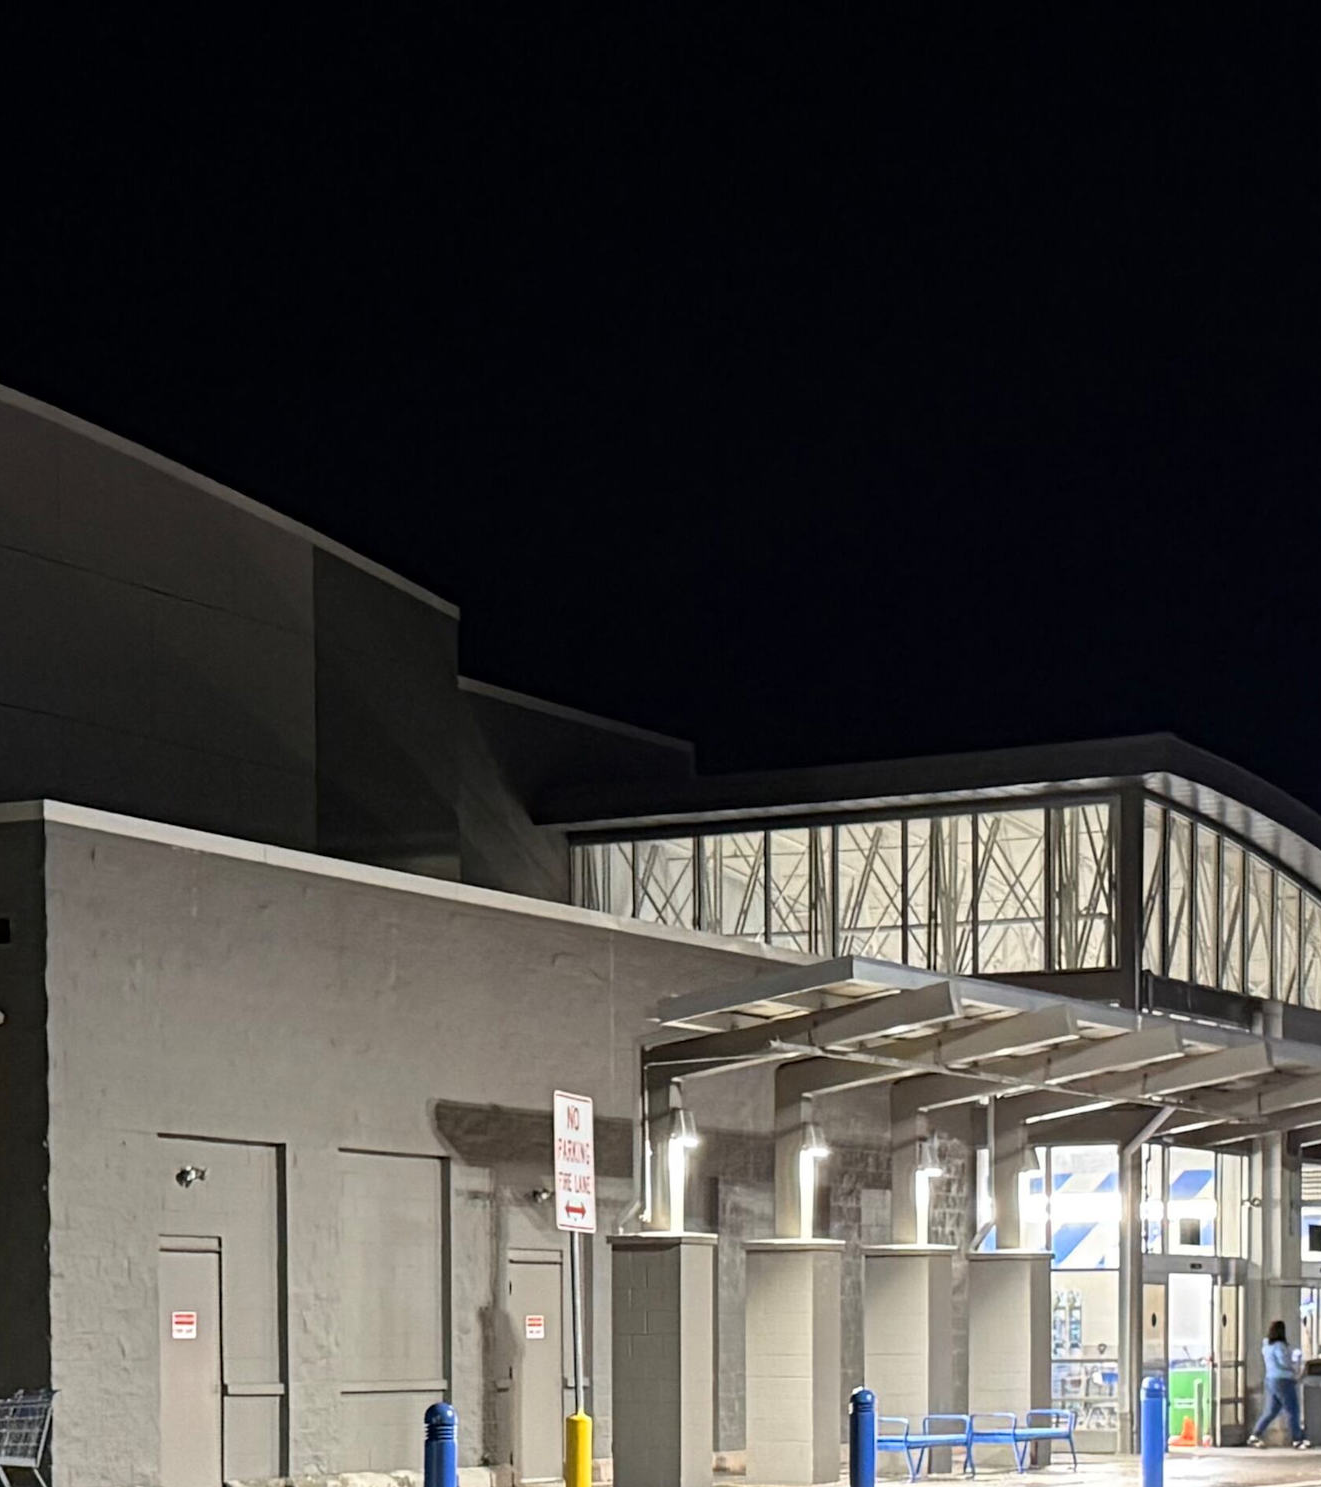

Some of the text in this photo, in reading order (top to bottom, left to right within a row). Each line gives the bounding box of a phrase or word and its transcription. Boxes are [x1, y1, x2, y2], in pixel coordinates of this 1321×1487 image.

[567, 1105, 580, 1131] NO
[557, 1137, 590, 1165] PARKING
[558, 1171, 591, 1195] FIRE LANE
